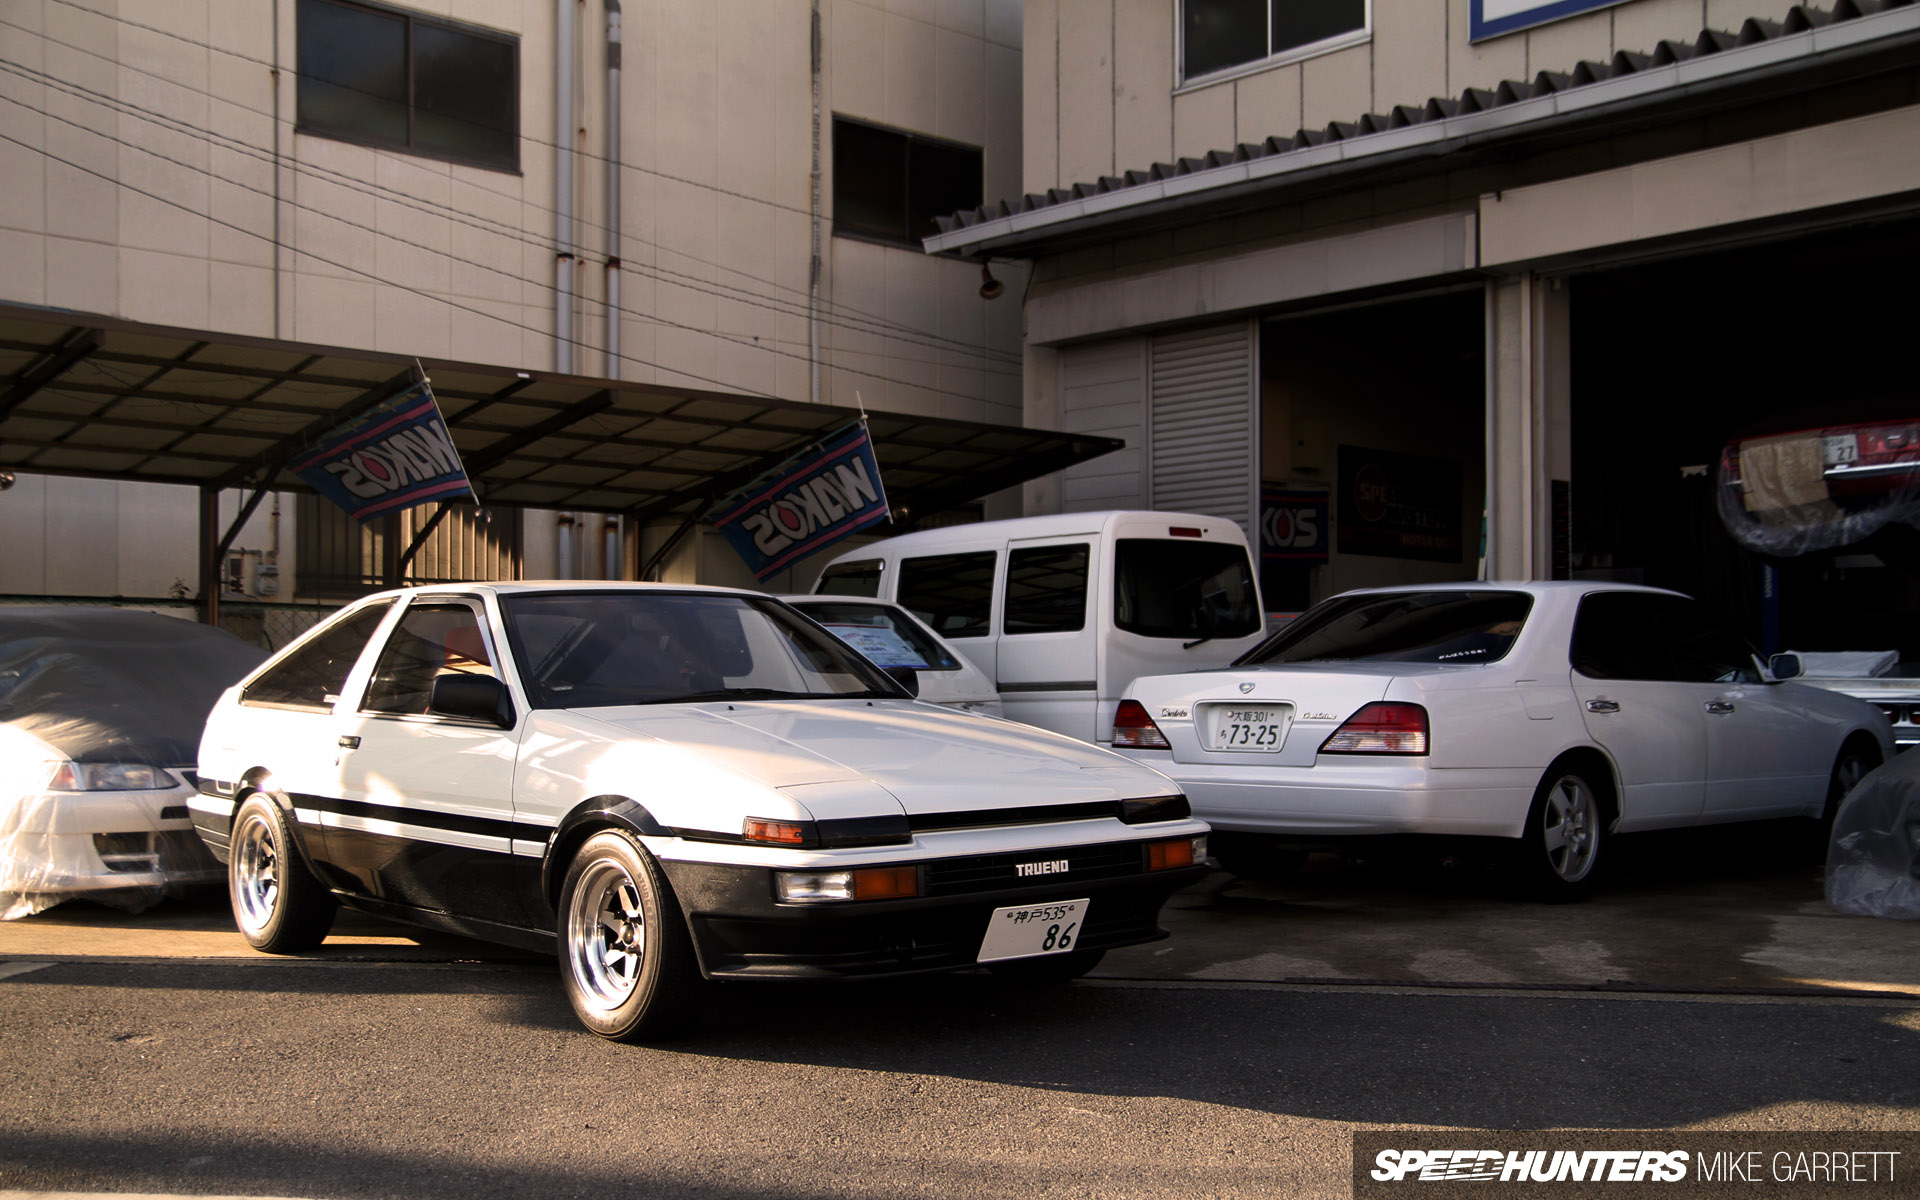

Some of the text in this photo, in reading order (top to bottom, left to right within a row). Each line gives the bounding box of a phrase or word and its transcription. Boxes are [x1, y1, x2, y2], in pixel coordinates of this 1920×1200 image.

[1837, 445, 1854, 461] 27
[1219, 724, 1279, 745] ち 73-25
[1015, 859, 1069, 877] TRUENO
[1014, 905, 1068, 924] 神戸535
[1042, 921, 1077, 951] 86
